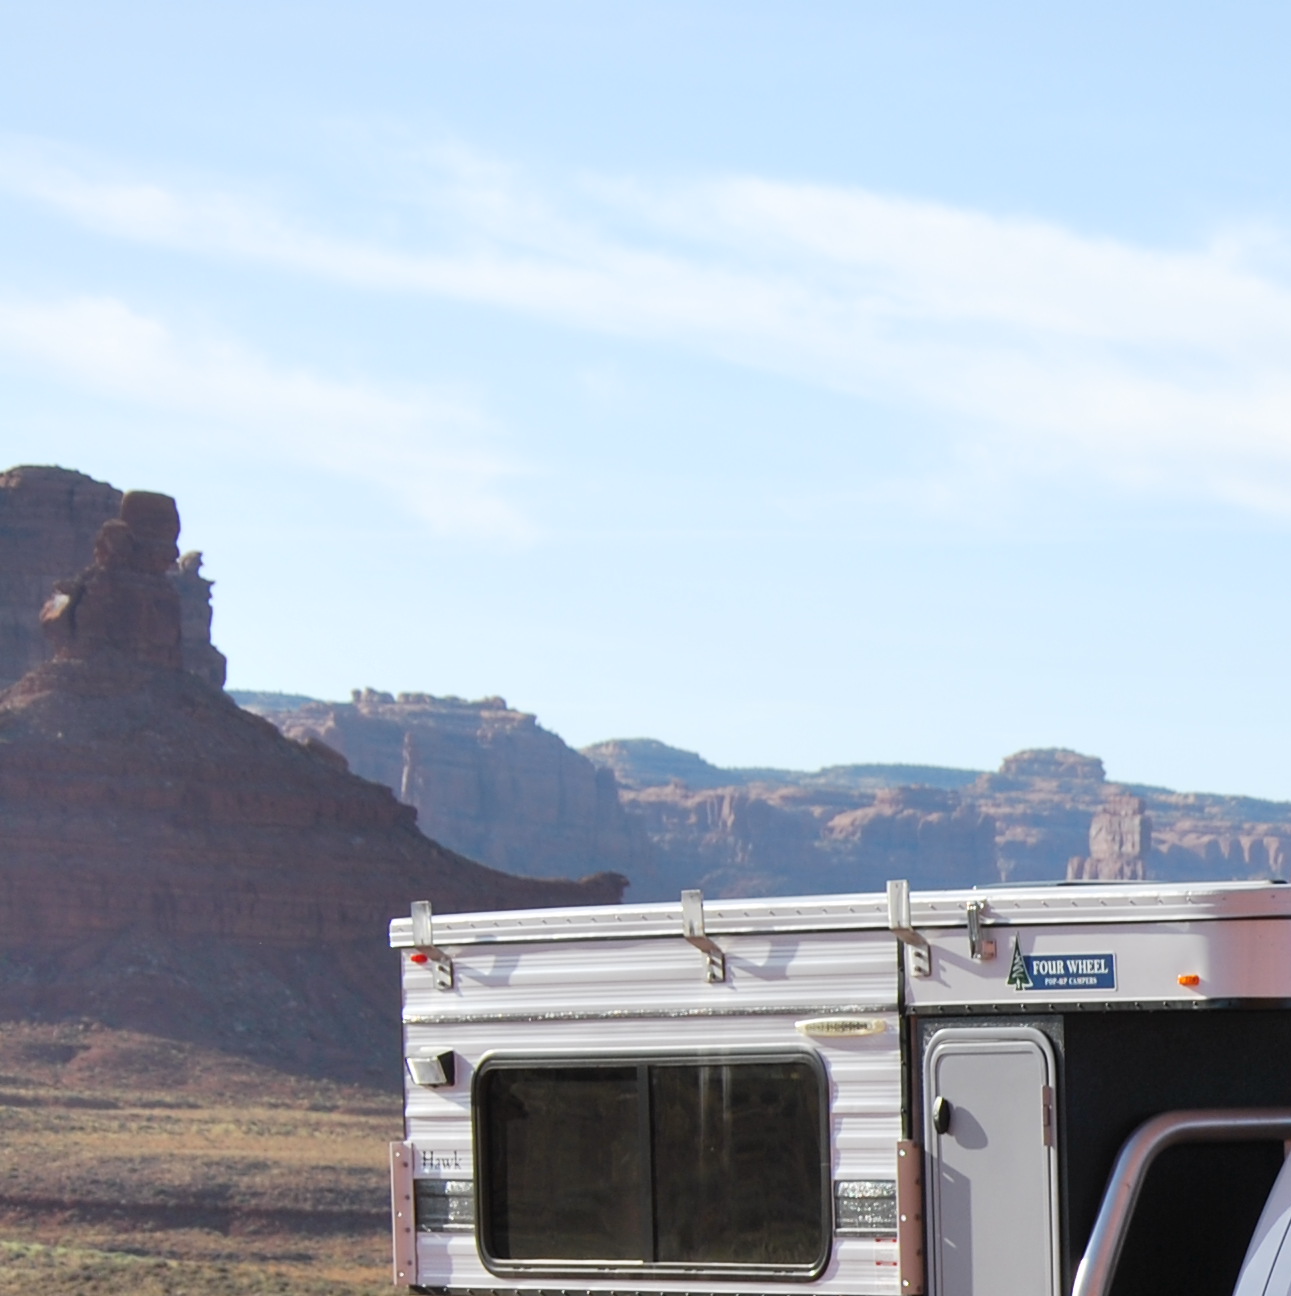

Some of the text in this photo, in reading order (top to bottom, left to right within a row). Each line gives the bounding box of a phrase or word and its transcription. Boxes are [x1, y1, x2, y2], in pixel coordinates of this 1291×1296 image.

[1033, 958, 1109, 975] FOUR WHEEL
[1069, 976, 1098, 985] CAMPERS
[423, 1150, 462, 1170] Hawk
